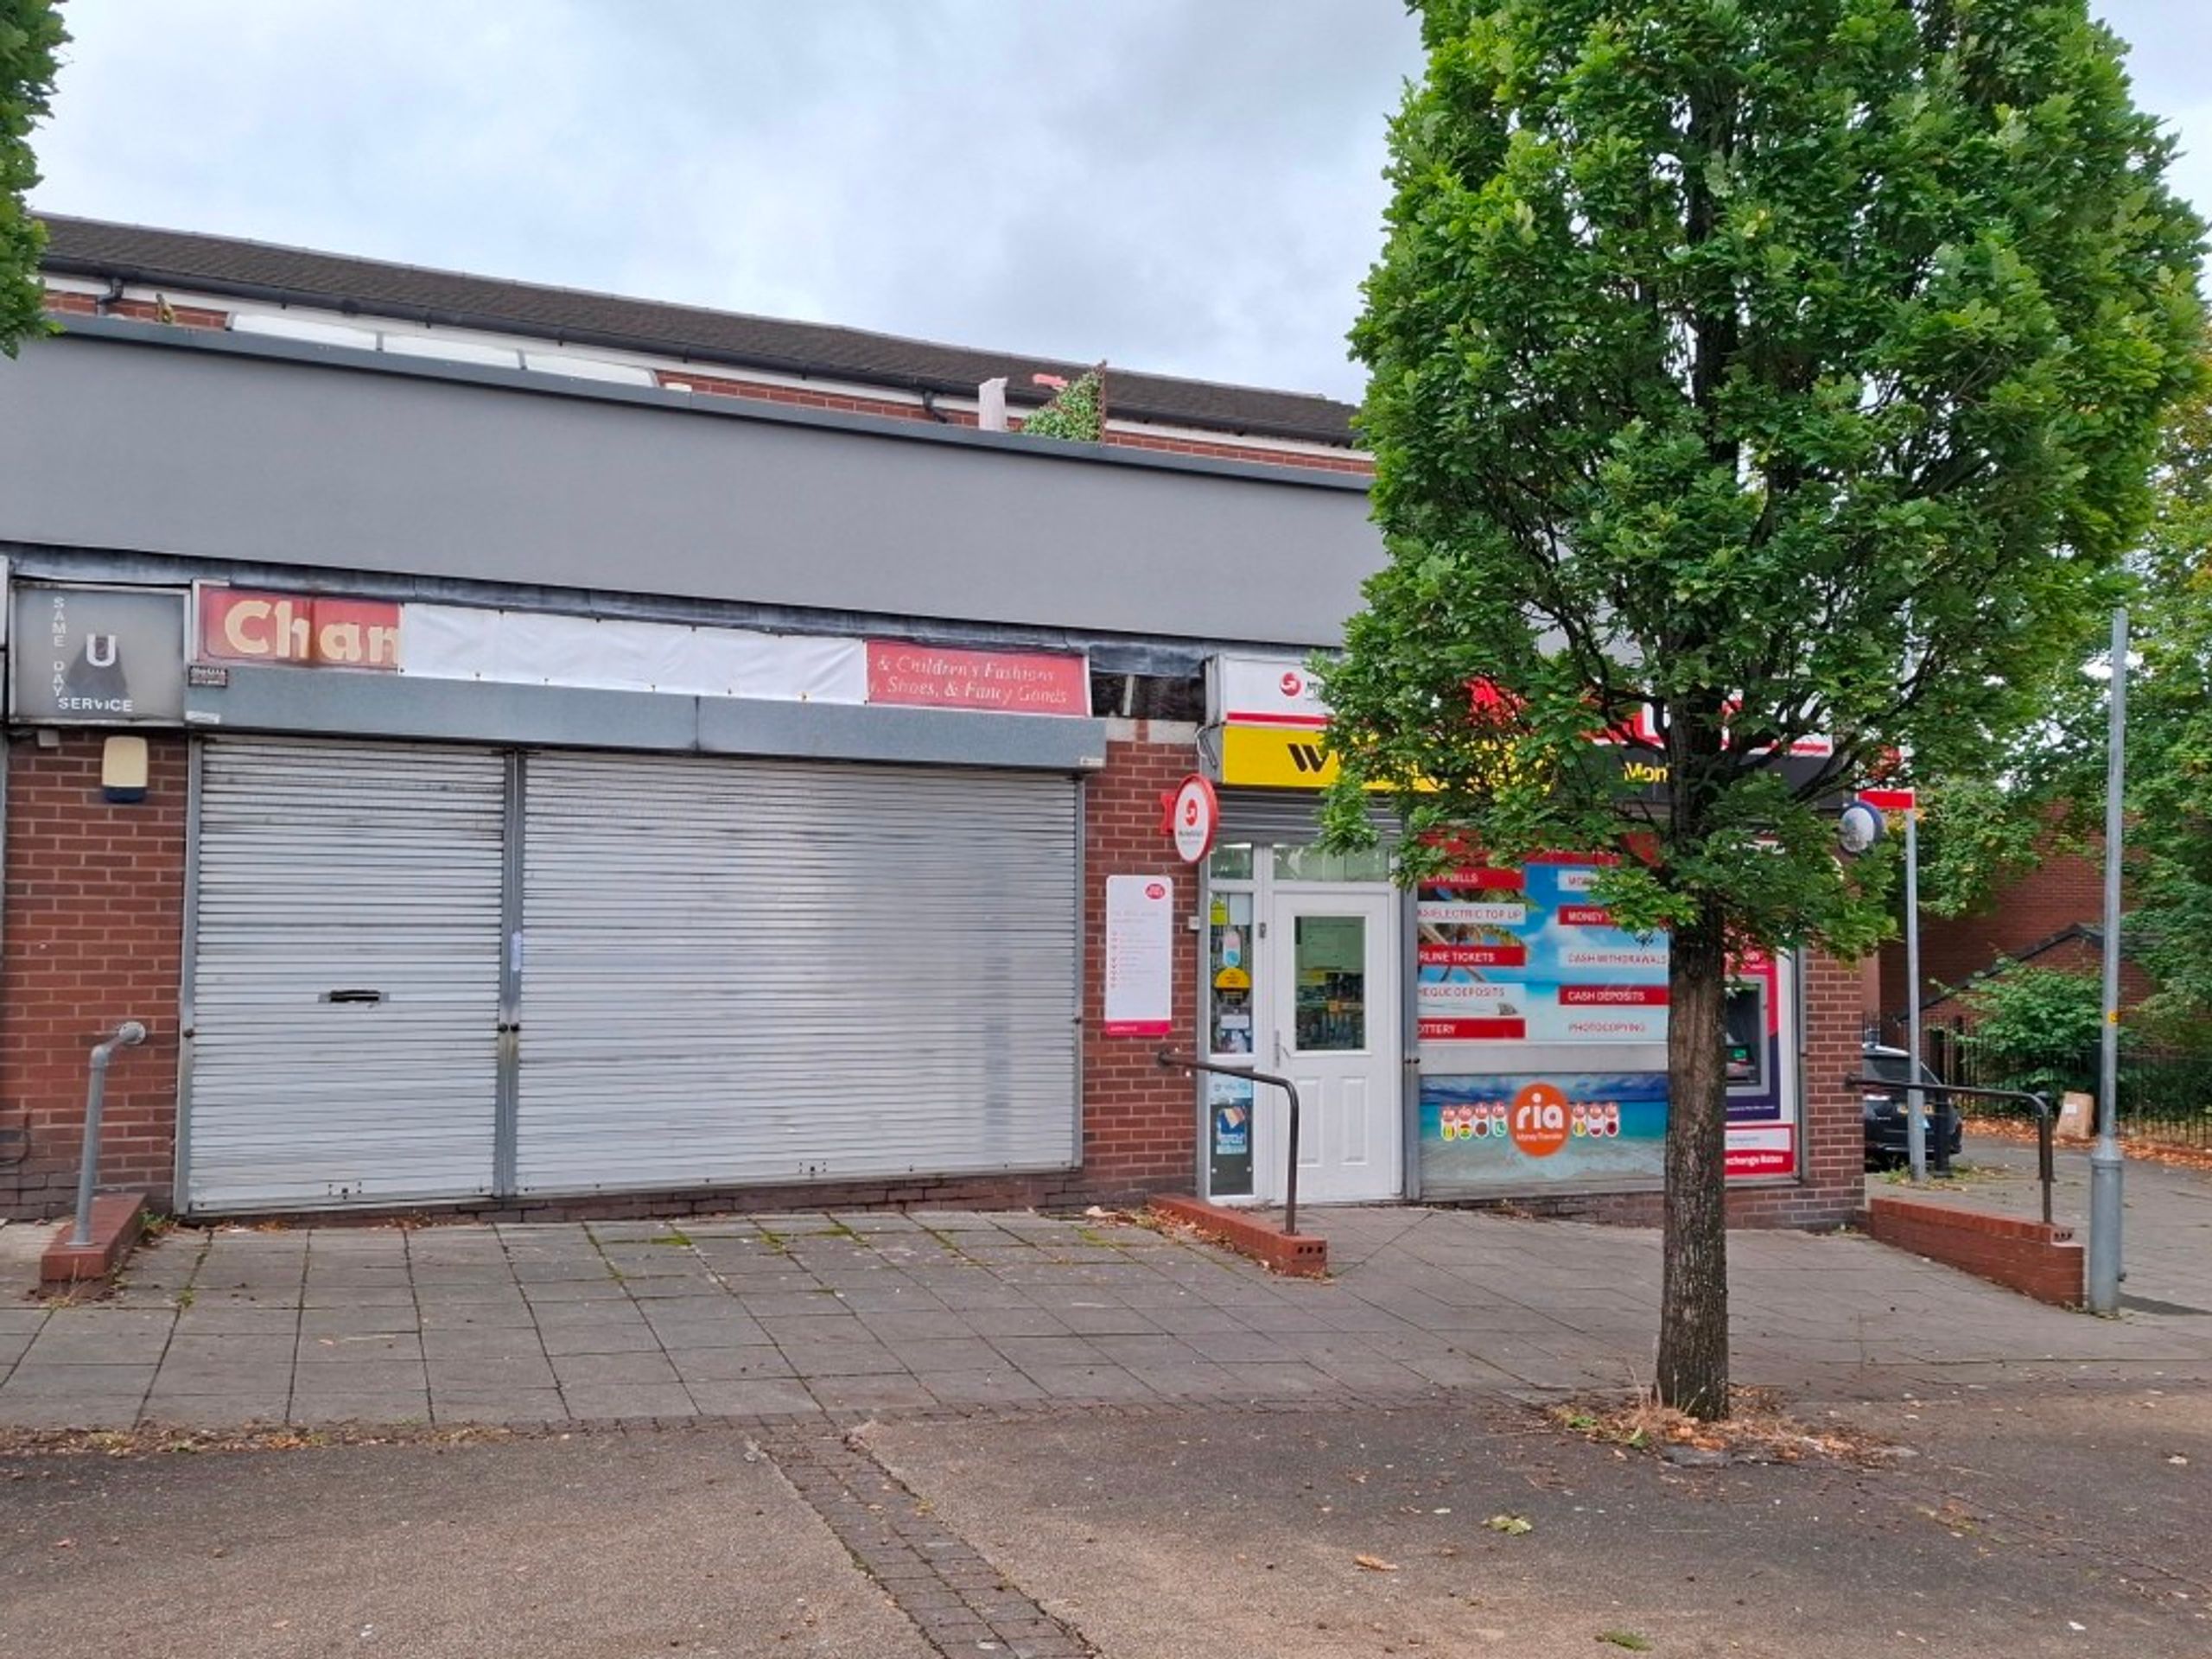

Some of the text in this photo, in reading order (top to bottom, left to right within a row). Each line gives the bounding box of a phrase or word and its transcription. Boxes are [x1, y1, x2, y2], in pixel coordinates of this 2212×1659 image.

[53, 596, 67, 697] SAME DAY
[965, 682, 1014, 705] Fancy
[58, 696, 134, 712] SERVICE
[1568, 910, 1604, 922] MONEY
[1452, 951, 1496, 963] TICKETS
[1567, 953, 1595, 964] CASH
[1453, 987, 1505, 998] DEPOSITS
[1567, 990, 1646, 1002] CASH DEPOSITS
[1516, 1092, 1564, 1129] ria
